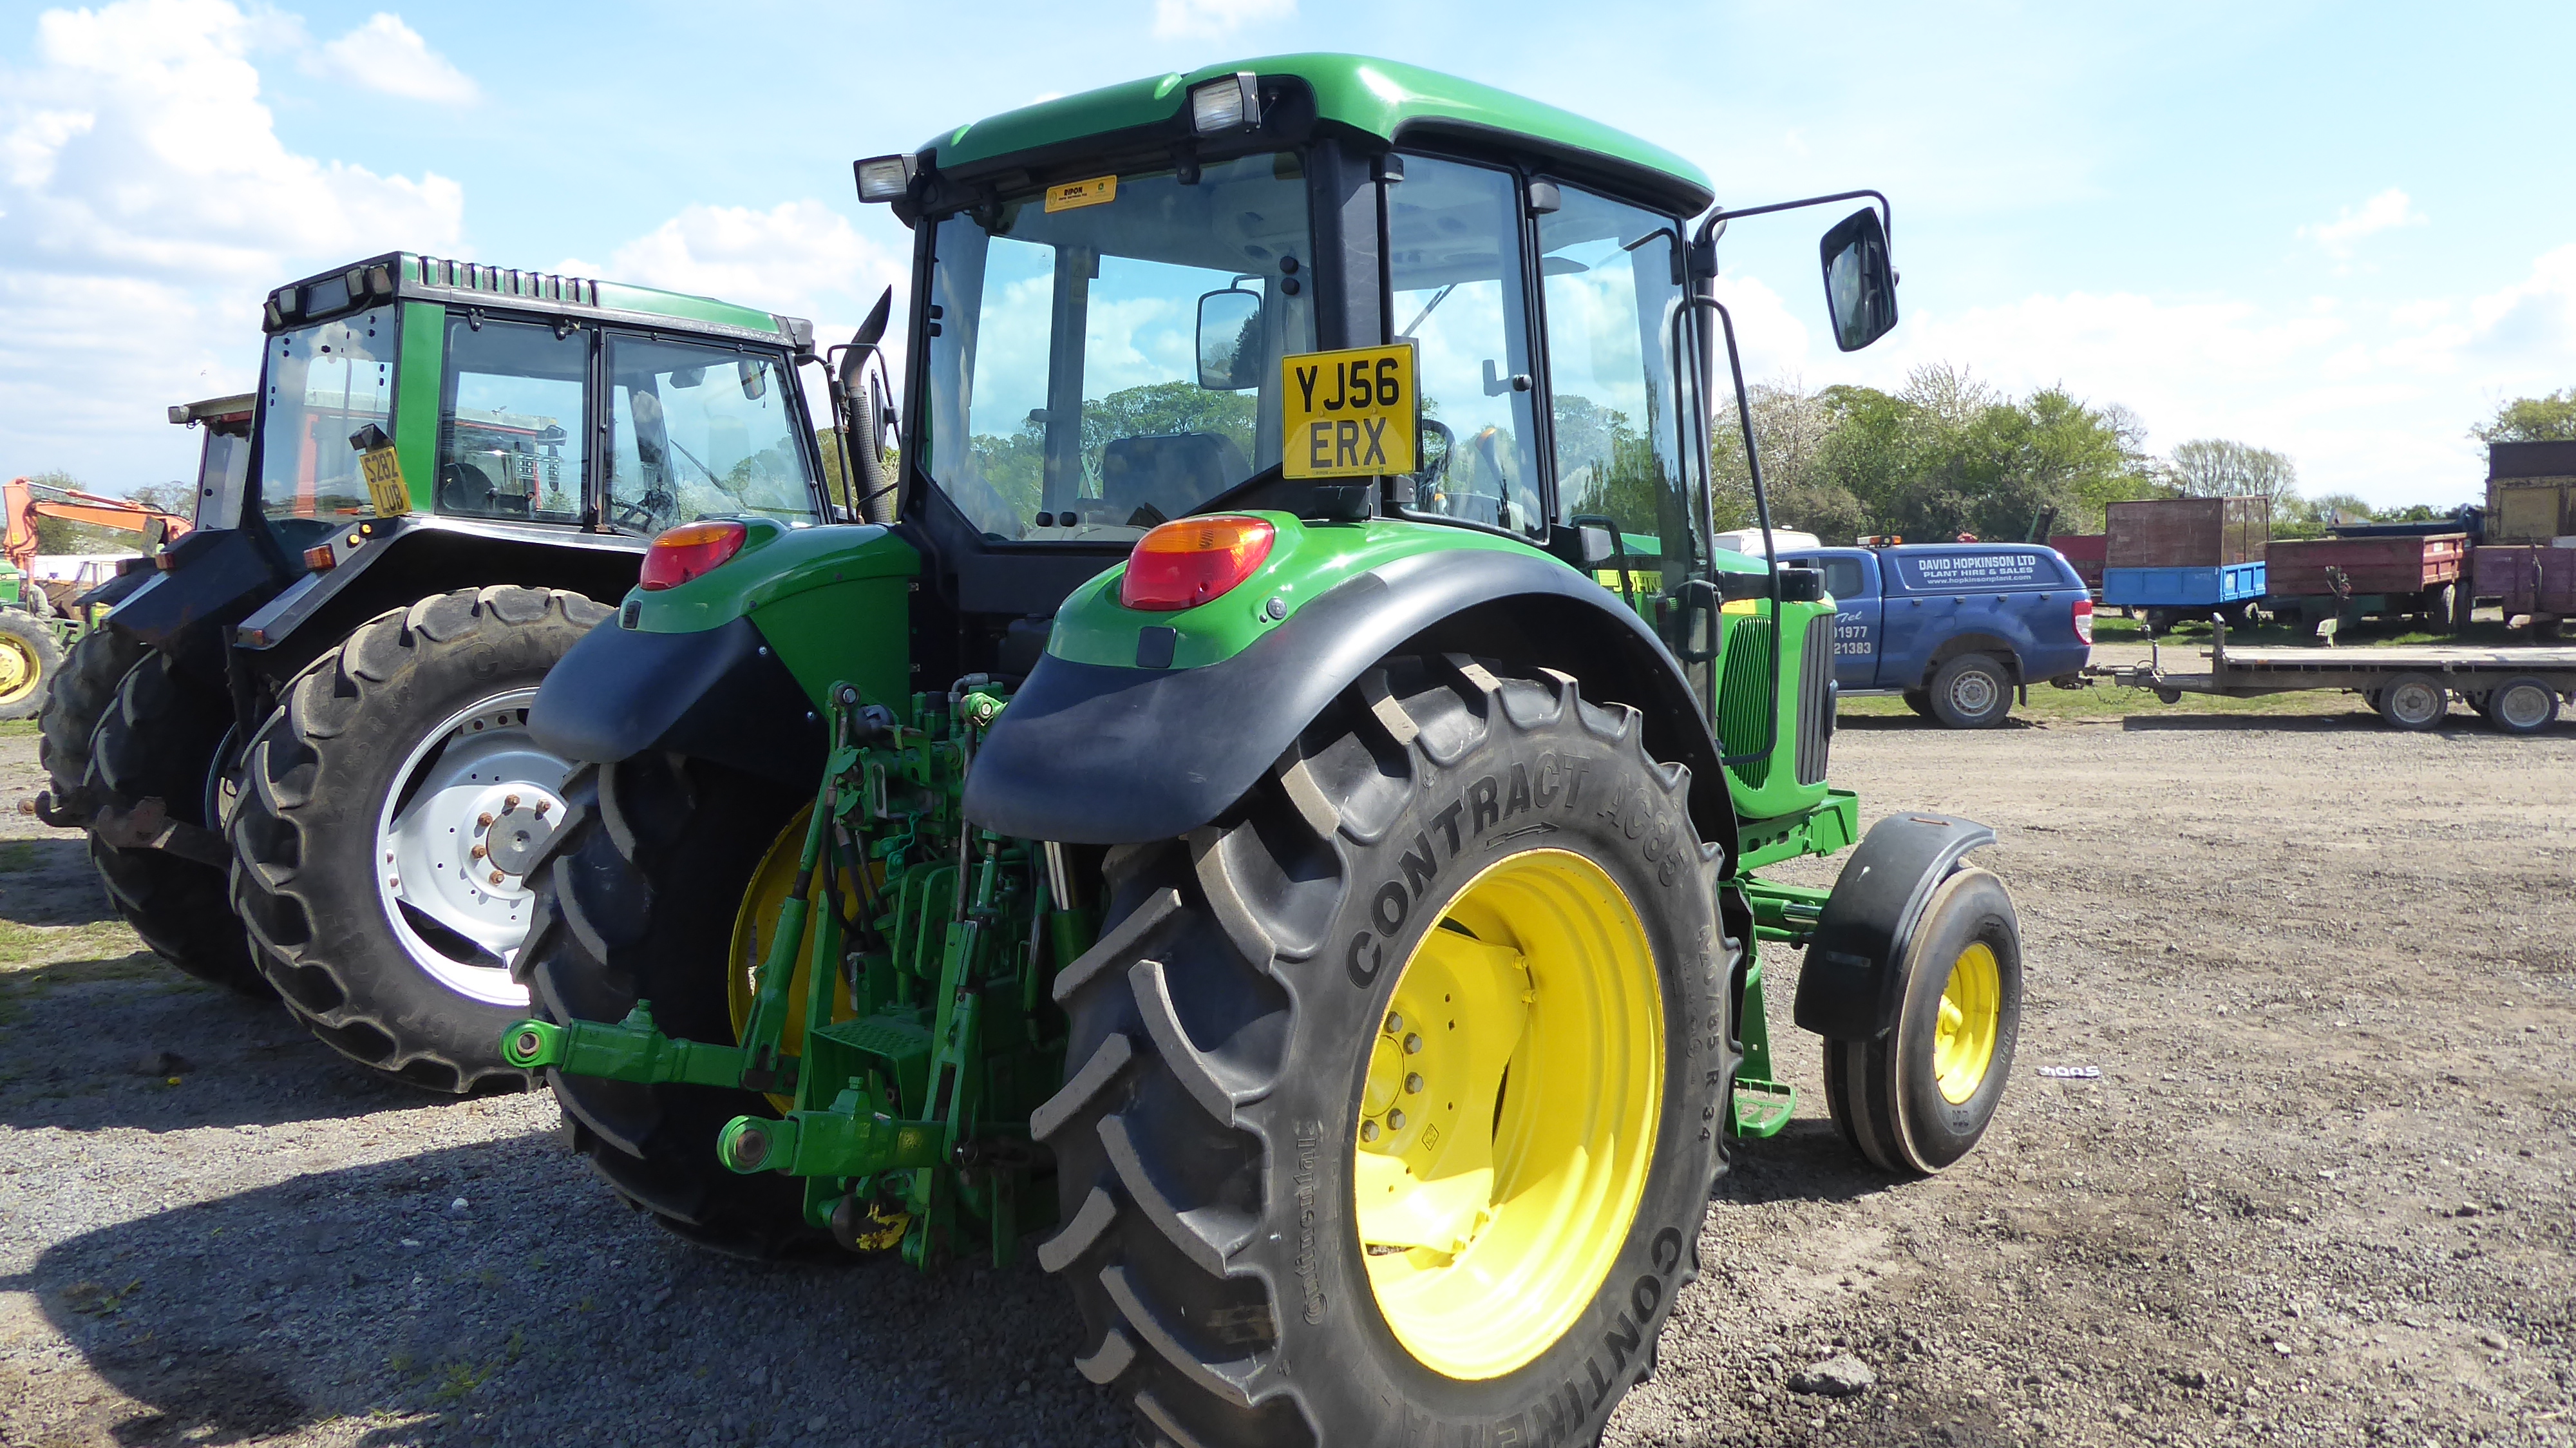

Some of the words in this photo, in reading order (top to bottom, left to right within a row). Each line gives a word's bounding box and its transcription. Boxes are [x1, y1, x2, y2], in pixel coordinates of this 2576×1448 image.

[1063, 186, 1083, 196] RIPON
[1295, 357, 1400, 414] YJ56
[1310, 416, 1387, 470] ERX
[364, 451, 399, 483] S282
[1918, 558, 1950, 571] DAVID
[1953, 555, 2014, 569] HOPKINSON
[2017, 555, 2036, 566] LTD
[1927, 575, 2032, 584] www.hopkinsonplant.com
[1834, 611, 1862, 623] Tel
[1345, 752, 1591, 989] CONTRACT
